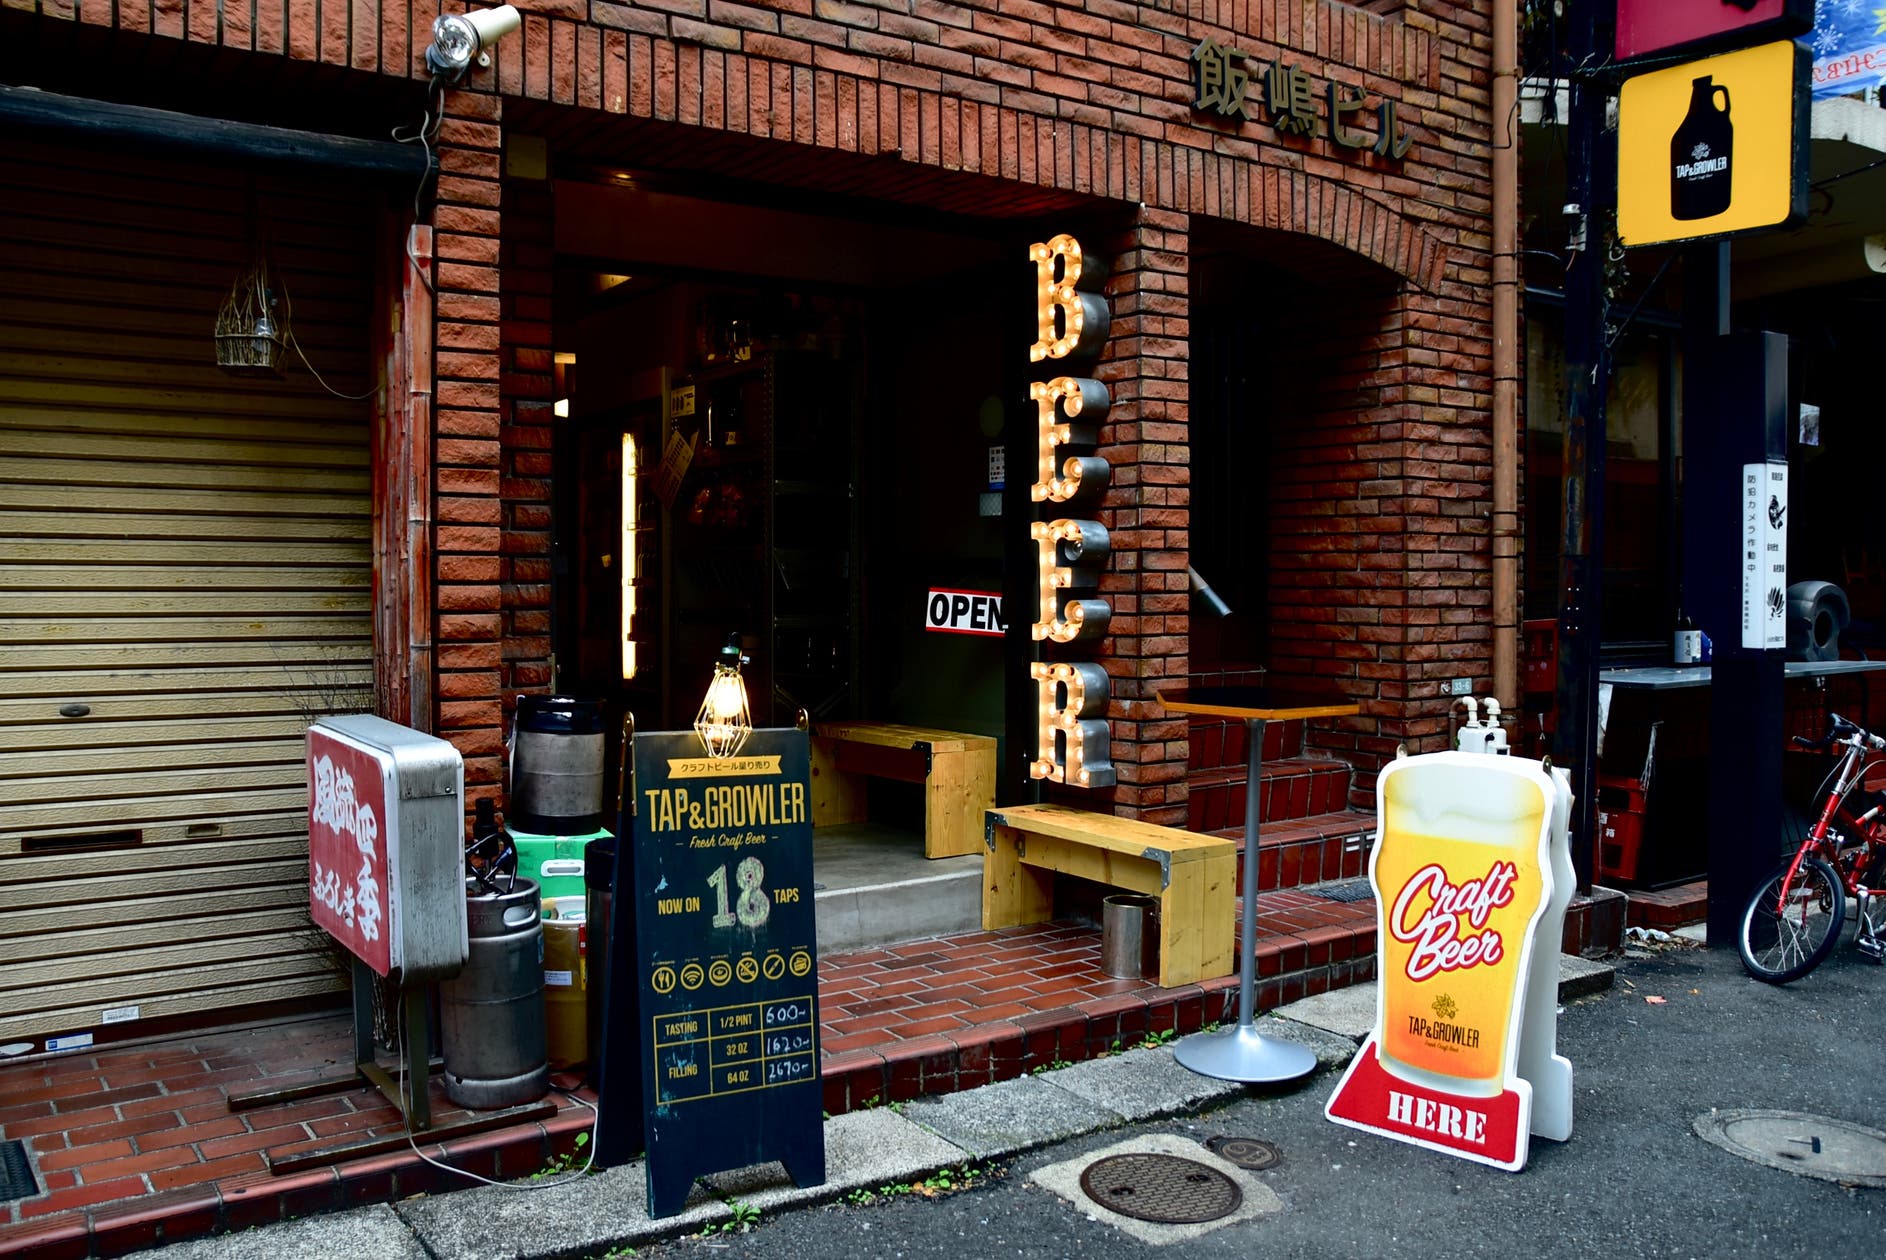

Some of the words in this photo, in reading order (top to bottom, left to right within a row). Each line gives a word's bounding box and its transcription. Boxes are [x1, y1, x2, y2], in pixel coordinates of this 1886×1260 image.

[1190, 37, 1414, 159] 飯嶋ビル
[1676, 156, 1727, 178] TAP&GROWLER
[1030, 233, 1090, 789] BEER
[929, 593, 1003, 632] OPEN
[680, 760, 771, 772] クラフトビール量り売り
[645, 782, 805, 832] TAP&GROWLER
[689, 835, 716, 849] Fresh
[718, 832, 744, 851] Craft
[745, 831, 767, 845] Beer
[658, 898, 682, 915] NOW
[685, 897, 700, 912] ON
[707, 856, 770, 928] 18
[773, 887, 800, 904] TAPS
[1390, 861, 1518, 943] Craft
[1405, 912, 1504, 982] Beer
[665, 1021, 698, 1036] TASTING
[720, 1015, 735, 1029] 1/2
[736, 1013, 752, 1027] PINT
[1409, 1015, 1480, 1048] TAP&GROWLER
[726, 1044, 737, 1056] 32
[738, 1042, 748, 1055] OZ
[668, 1063, 698, 1079] FILLING
[727, 1072, 738, 1084] 64
[739, 1070, 749, 1082] OZ
[1387, 1090, 1487, 1145] HERE
